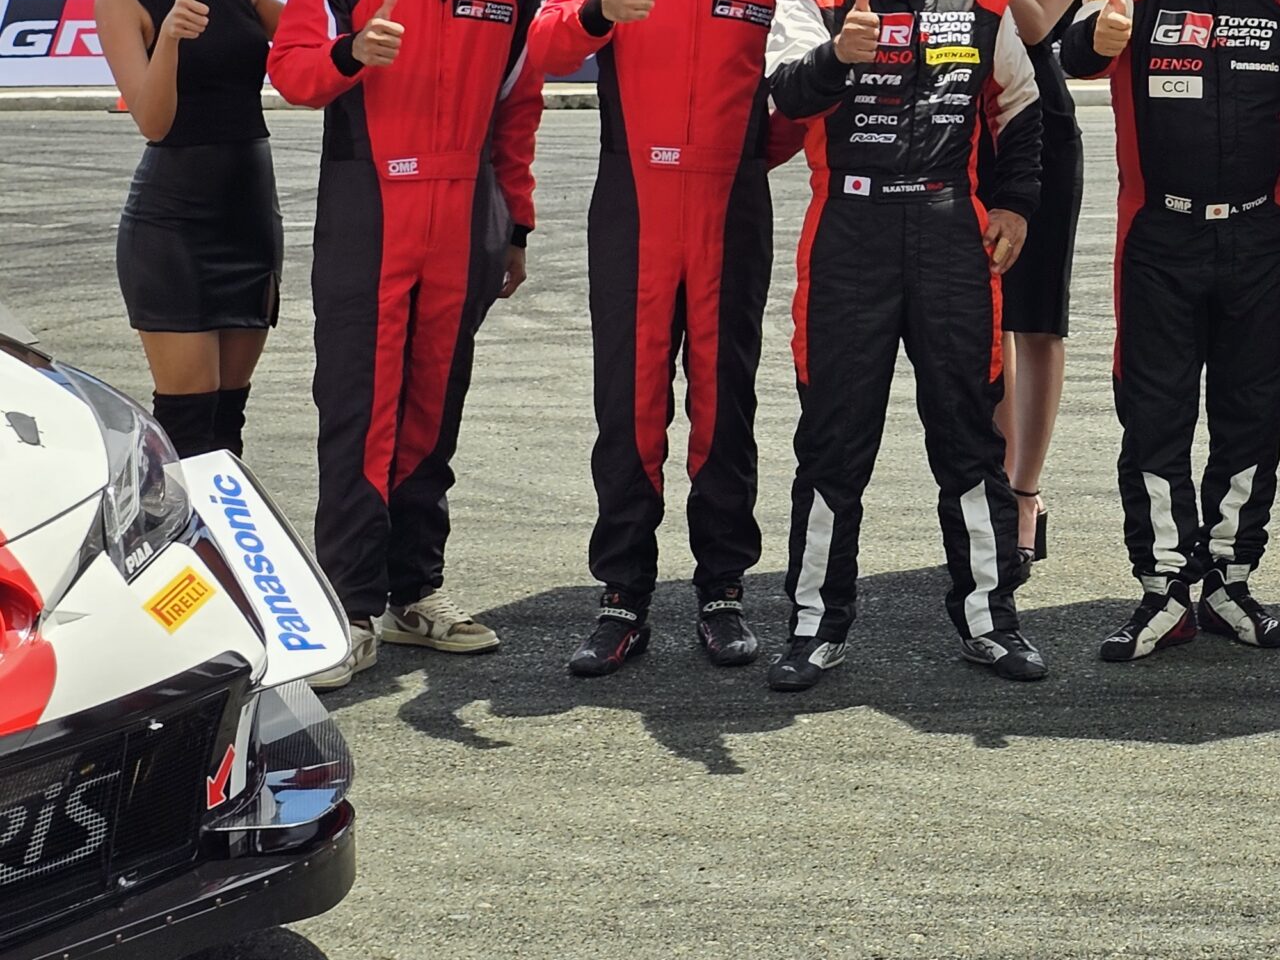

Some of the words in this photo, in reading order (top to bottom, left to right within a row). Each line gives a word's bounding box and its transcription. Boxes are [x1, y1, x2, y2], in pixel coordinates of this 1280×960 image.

[715, 5, 744, 18] GR
[920, 11, 976, 22] TOYOTA
[920, 21, 971, 33] GAZOO
[1217, 15, 1278, 29] TOYOTA
[1, 20, 103, 55] GR
[881, 25, 909, 43] R
[1155, 24, 1208, 45] GR
[1215, 27, 1273, 38] GAZOO
[1212, 36, 1270, 50] Racing
[876, 50, 913, 64] NSO
[935, 51, 977, 60] DUNLOP
[1149, 58, 1203, 71] DENSO
[1230, 60, 1280, 72] Panasonic
[650, 150, 680, 163] OMP
[388, 161, 418, 174] OMP
[1164, 196, 1192, 211] OMP
[125, 541, 154, 574] PIAA
[210, 473, 325, 653] Panasonic
[150, 573, 208, 627] PIRELLI
